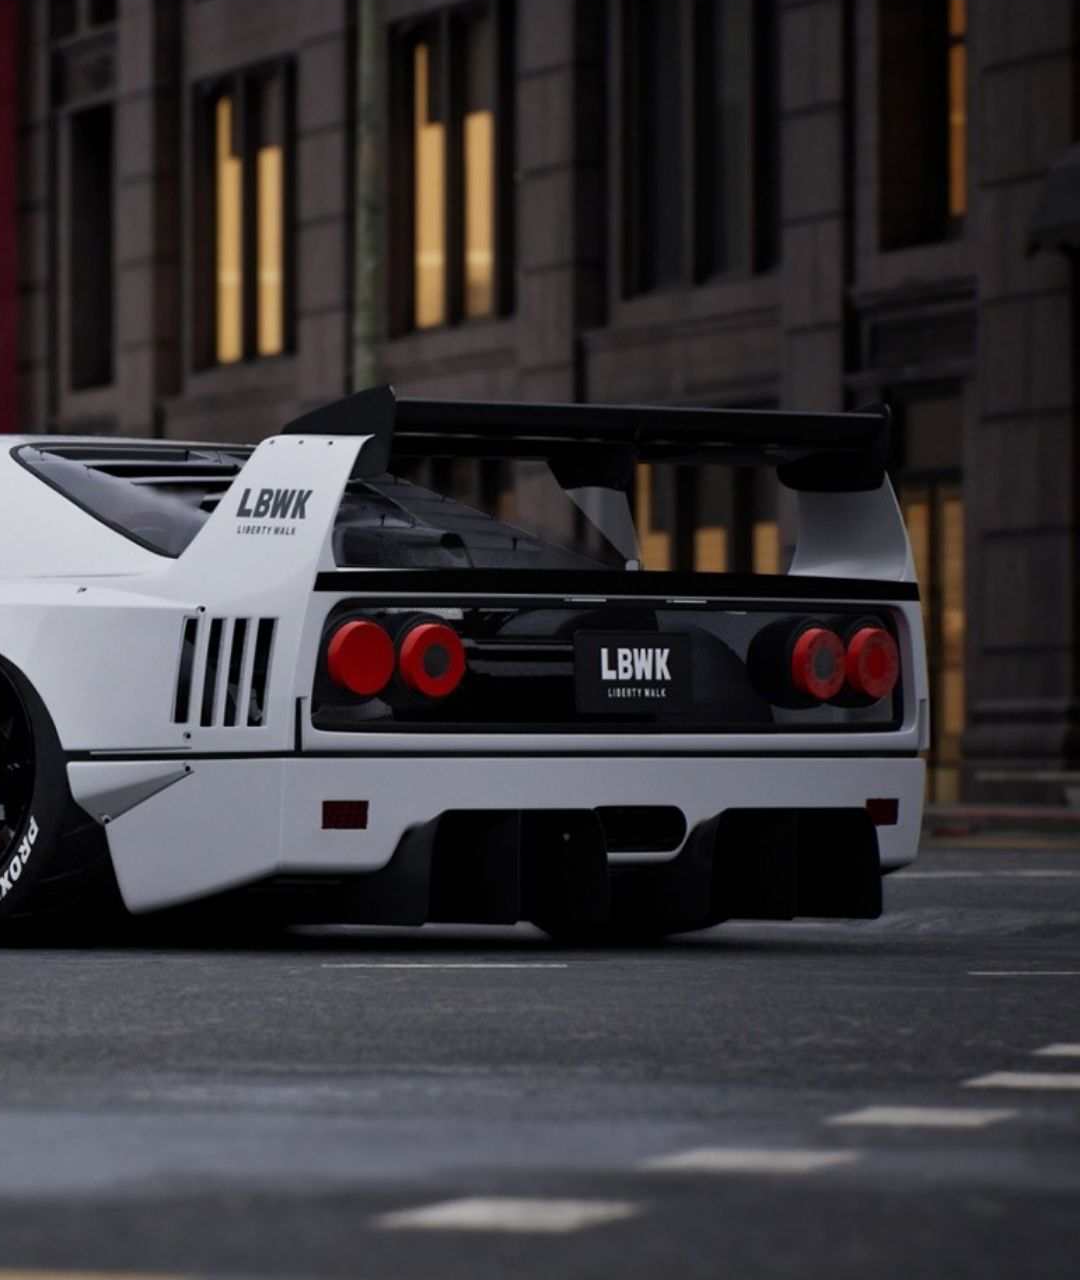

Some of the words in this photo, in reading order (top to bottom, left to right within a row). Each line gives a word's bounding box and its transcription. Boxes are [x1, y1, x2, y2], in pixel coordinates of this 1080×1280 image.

[236, 488, 314, 519] LBWK
[236, 525, 272, 535] LIBERTY
[273, 525, 296, 536] WALK
[600, 647, 672, 680] LBWK
[607, 687, 642, 698] LIBERTY
[643, 687, 667, 698] WALK
